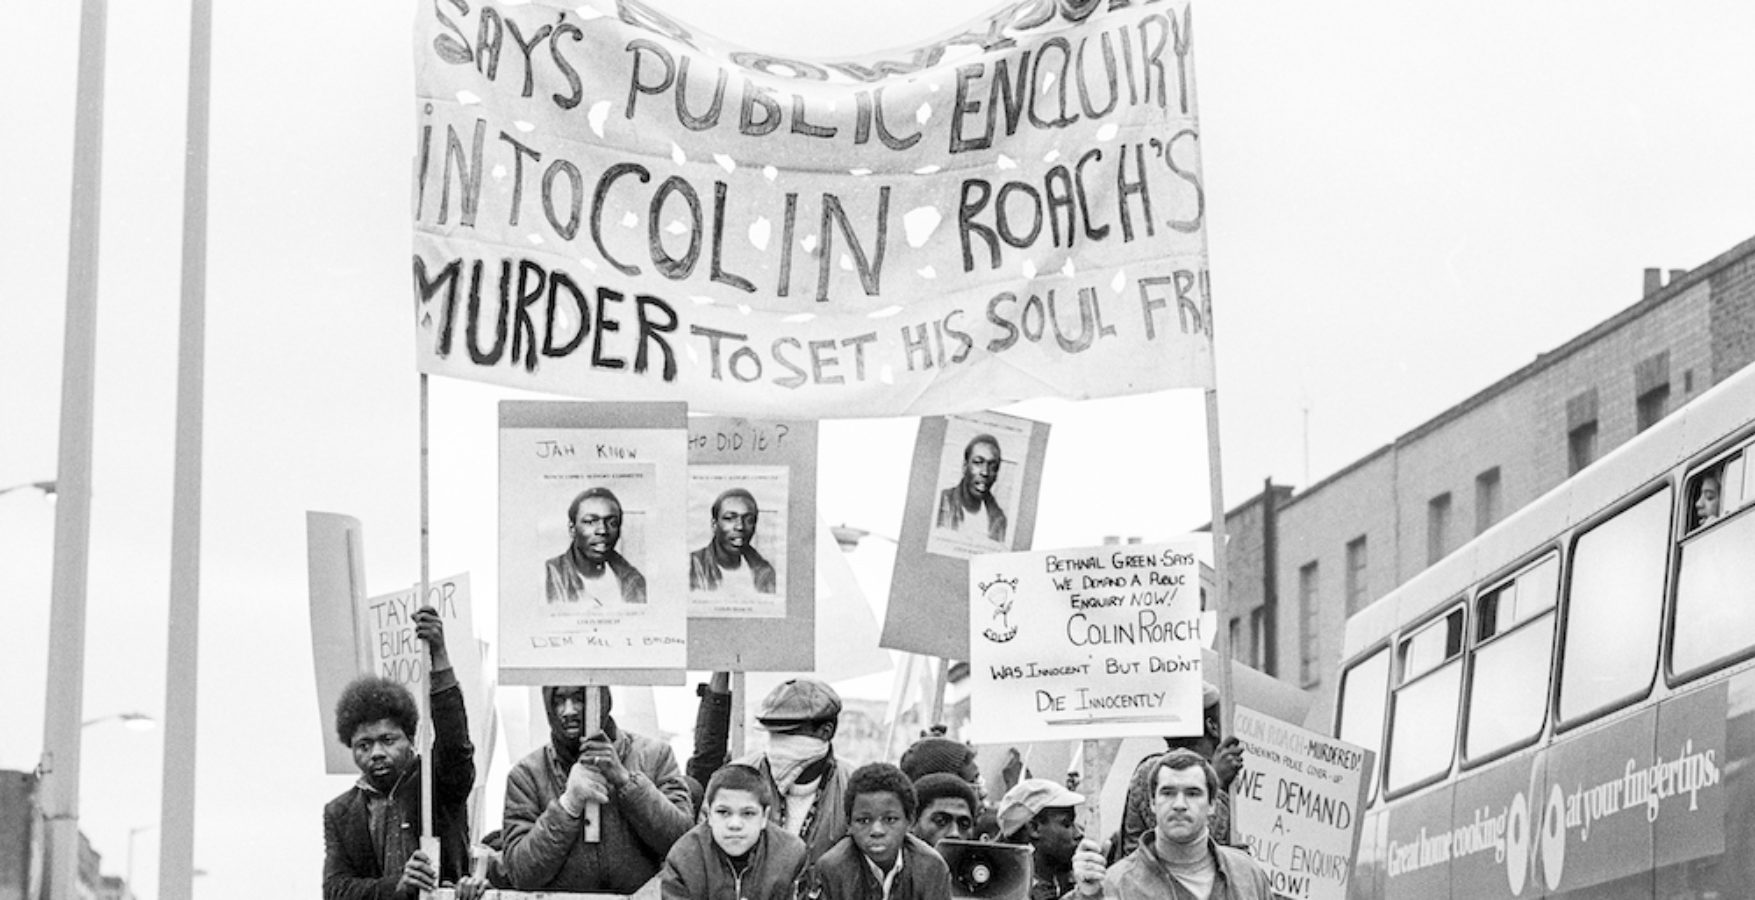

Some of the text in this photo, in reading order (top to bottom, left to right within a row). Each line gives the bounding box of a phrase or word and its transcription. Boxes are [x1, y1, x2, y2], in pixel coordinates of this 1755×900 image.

[625, 38, 922, 151] PUBLIC
[949, 3, 1192, 154] ENQUIRY
[590, 162, 891, 302] COLIN
[957, 129, 1206, 273] ROACH'S
[412, 253, 679, 382] MURDER
[771, 332, 878, 390] SET
[900, 308, 973, 371] HIS
[985, 285, 1117, 353] SOUL
[536, 440, 575, 459] JAH
[687, 432, 707, 452] HO
[1046, 555, 1105, 573] BETHNAL
[1052, 571, 1185, 591] WE DEMAND A PUBLIC
[370, 582, 456, 629] TAYLOR
[1071, 588, 1178, 609] ENQUIRY NOW!
[1067, 609, 1200, 646] COLIN ROACH
[990, 665, 1023, 680] WAS
[1026, 662, 1090, 678] INNOCENT
[1106, 658, 1141, 674] BUT
[1036, 688, 1166, 712] DIE INNOCENTLY
[1236, 769, 1351, 830] WE DEMAND
[1453, 805, 1508, 864] cooking
[1567, 783, 1582, 828] at
[1581, 778, 1623, 842] your
[1623, 739, 1721, 823] fingertips.
[1246, 834, 1350, 887] BLIC ENQUIRY
[1261, 869, 1310, 899] NOW!
